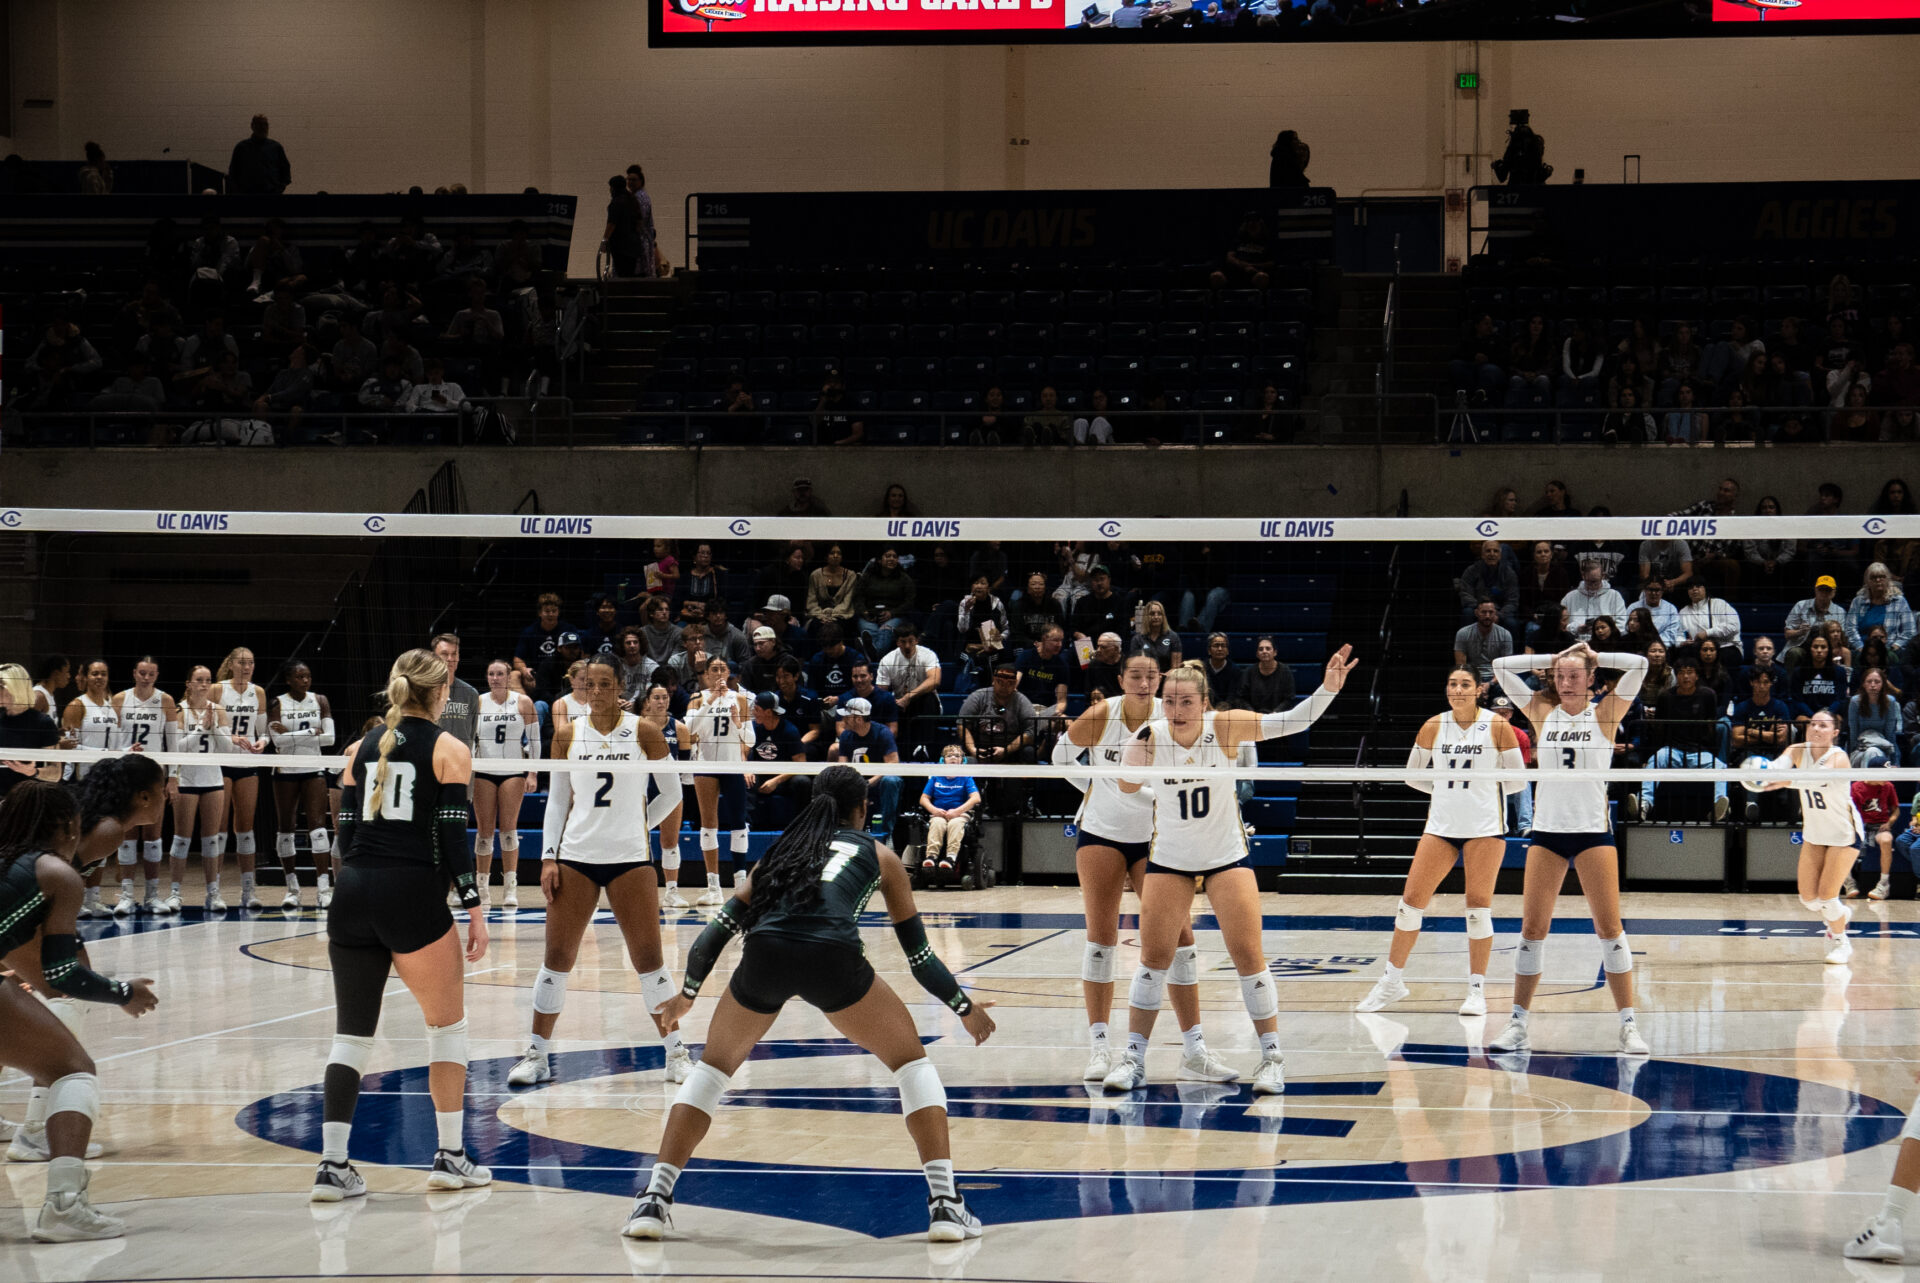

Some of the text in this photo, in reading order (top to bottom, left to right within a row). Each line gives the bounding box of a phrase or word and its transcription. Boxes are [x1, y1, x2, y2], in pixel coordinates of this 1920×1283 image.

[1460, 74, 1477, 88] EXIT
[1304, 194, 1327, 207] 216
[1496, 193, 1520, 204] 217
[704, 203, 728, 216] 216
[1753, 199, 1897, 240] AGGIES
[929, 208, 1097, 249] UC DAVIS
[157, 514, 229, 530] UC DAVIS
[520, 518, 592, 534] UC DAVIS
[888, 521, 960, 537] UC DAVIS
[1260, 521, 1335, 537] UC DAVIS
[1641, 519, 1717, 536] UC DAVIS
[232, 715, 249, 735] 15
[496, 724, 506, 743] 6
[713, 716, 730, 736] 13
[105, 727, 111, 749] 1
[132, 723, 150, 745] 12
[1547, 731, 1591, 742] UC DAVIS
[199, 735, 208, 753] 5
[1442, 744, 1482, 755] UC DAVIS
[1104, 749, 1119, 761] UC
[1562, 747, 1576, 769] 3
[594, 772, 614, 807] 2
[1177, 787, 1209, 820] 10
[1805, 789, 1827, 810] 18
